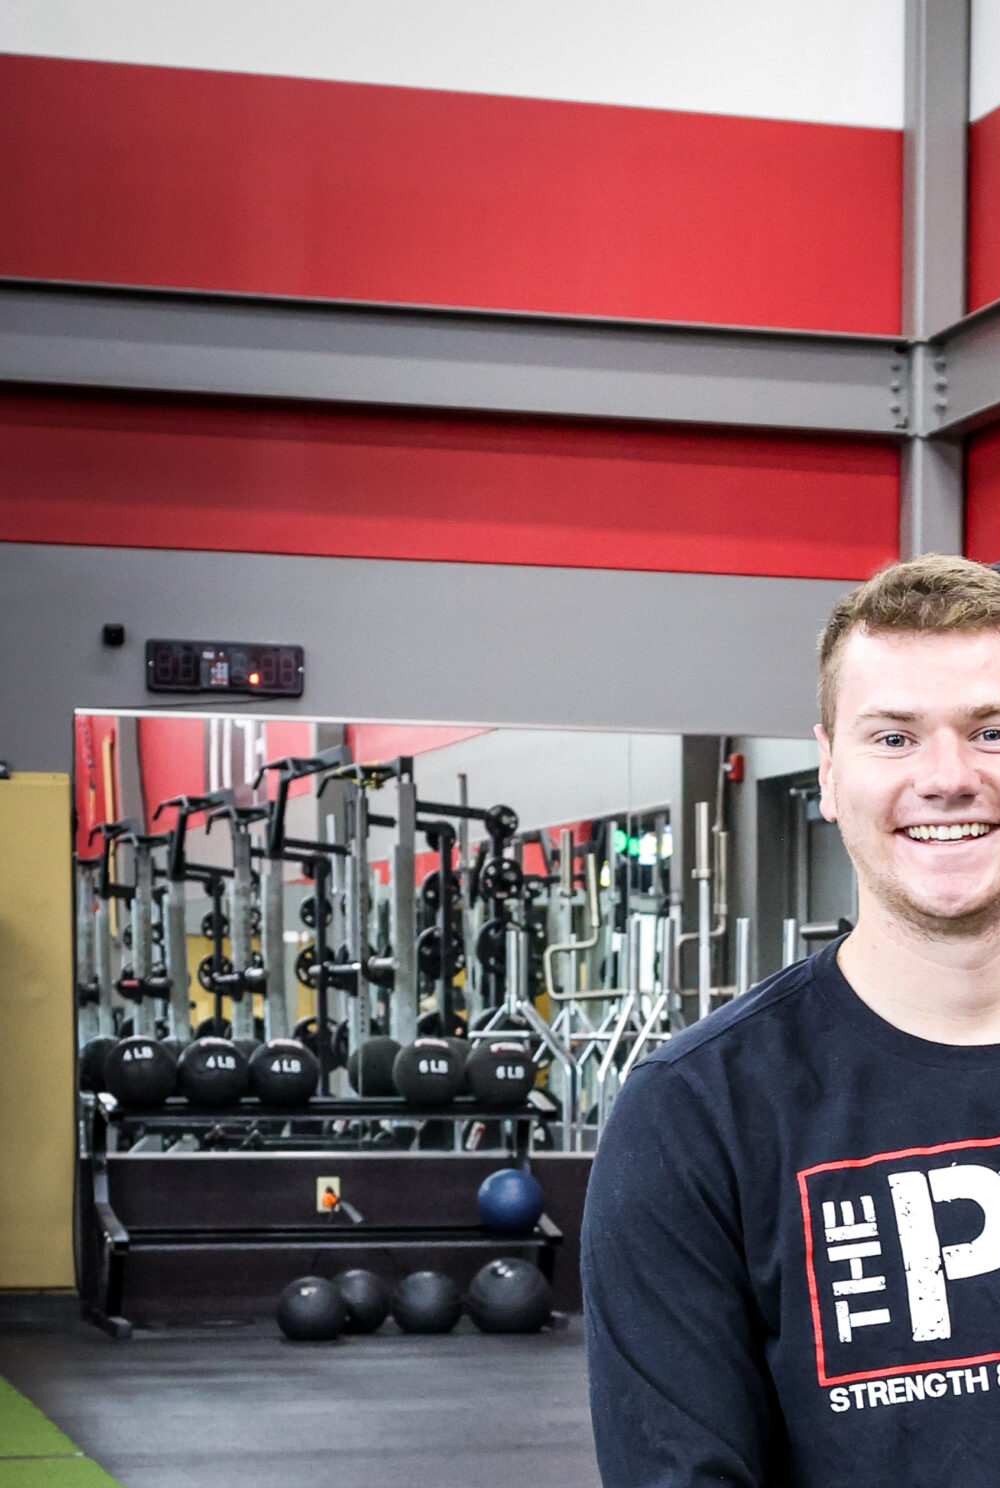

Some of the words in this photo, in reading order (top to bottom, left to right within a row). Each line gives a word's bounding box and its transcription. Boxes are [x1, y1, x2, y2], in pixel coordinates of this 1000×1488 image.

[123, 1049, 132, 1062] 4
[133, 1046, 154, 1060] LB
[206, 1055, 216, 1069] 4
[217, 1056, 237, 1070] LB
[270, 1059, 281, 1074] 4
[283, 1059, 302, 1074] LB
[418, 1059, 429, 1074] 6
[430, 1059, 449, 1074] LB
[495, 1065, 506, 1080] 6
[507, 1065, 526, 1080] LB
[822, 1195, 891, 1343] THE
[829, 1366, 990, 1413] STRENGTH
